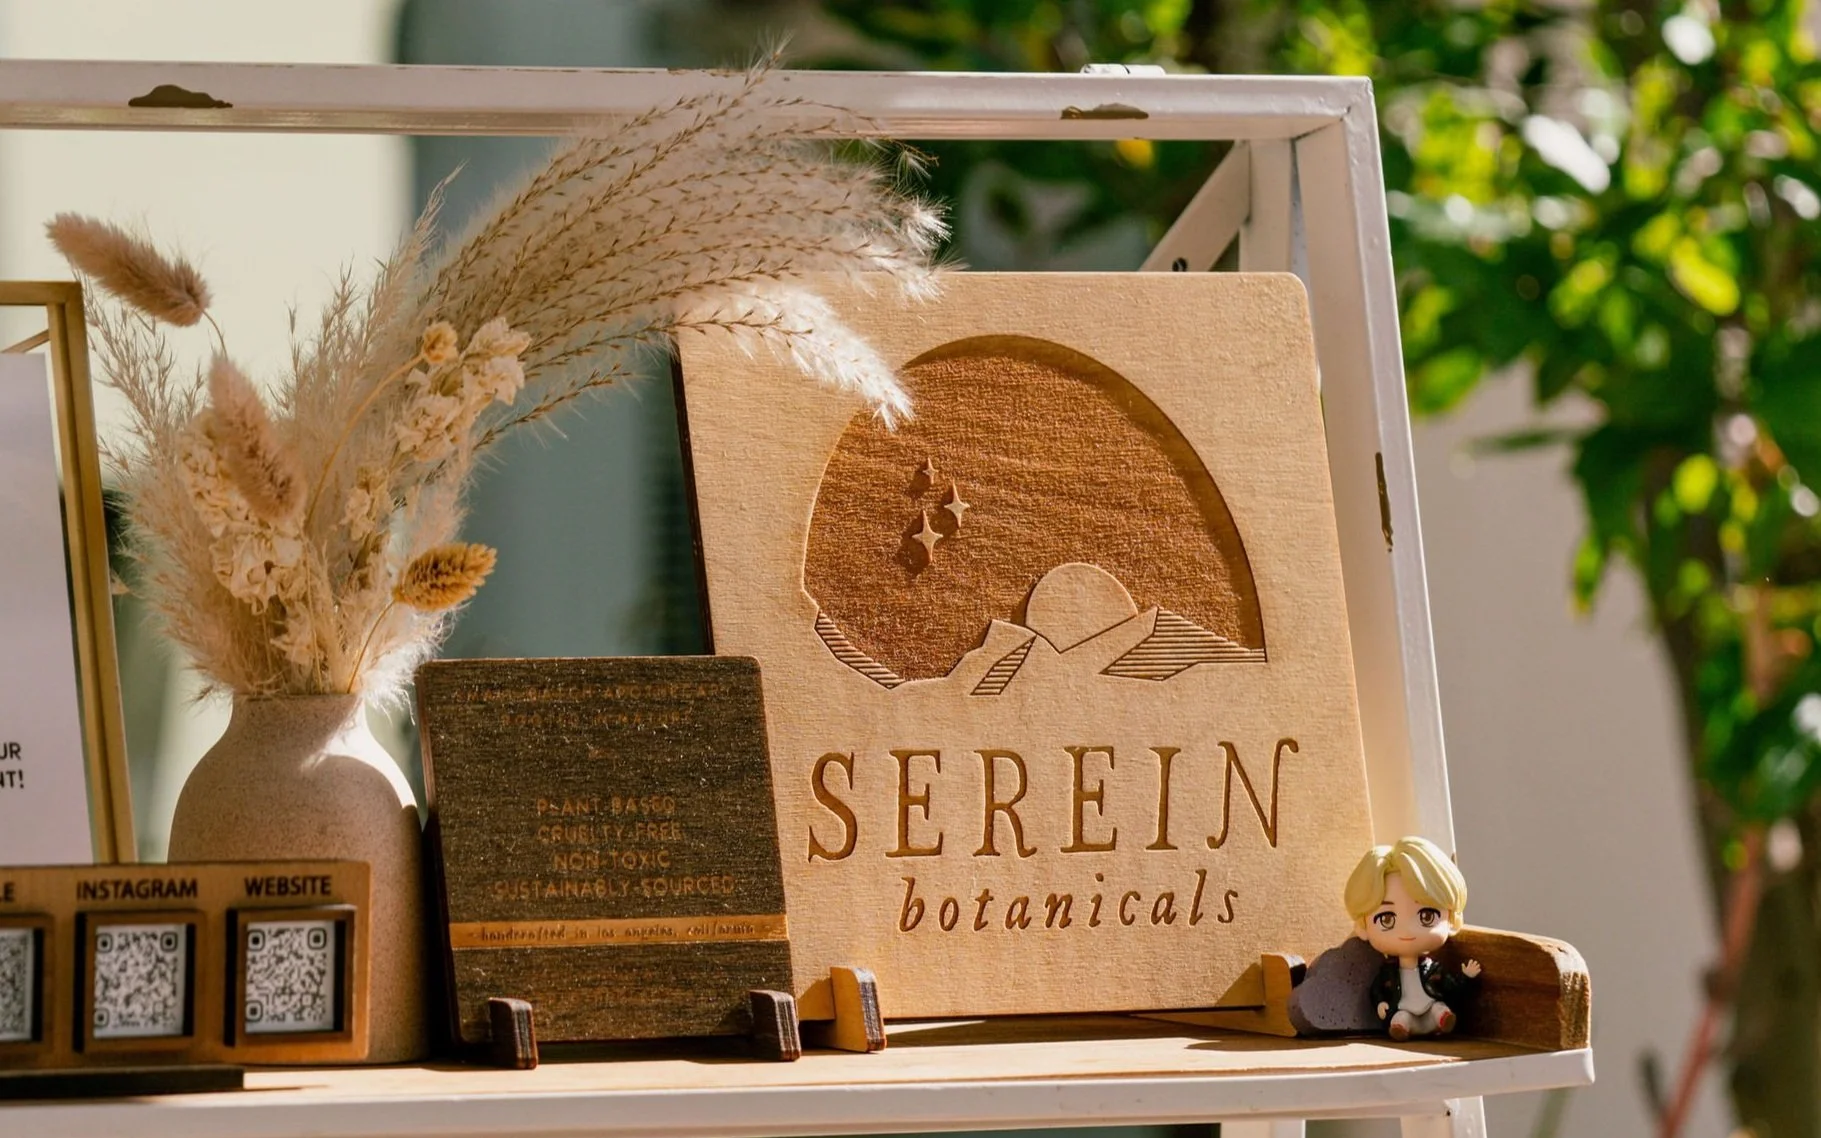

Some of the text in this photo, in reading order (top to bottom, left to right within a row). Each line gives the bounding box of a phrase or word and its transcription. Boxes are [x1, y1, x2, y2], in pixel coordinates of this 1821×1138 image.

[807, 737, 1299, 864] SEREIN
[76, 878, 198, 901] INSTAGRAM
[244, 875, 332, 897] WEBSITE
[494, 875, 736, 899] SUSTAINABLY SOURCED
[899, 868, 1239, 932] botanicals
